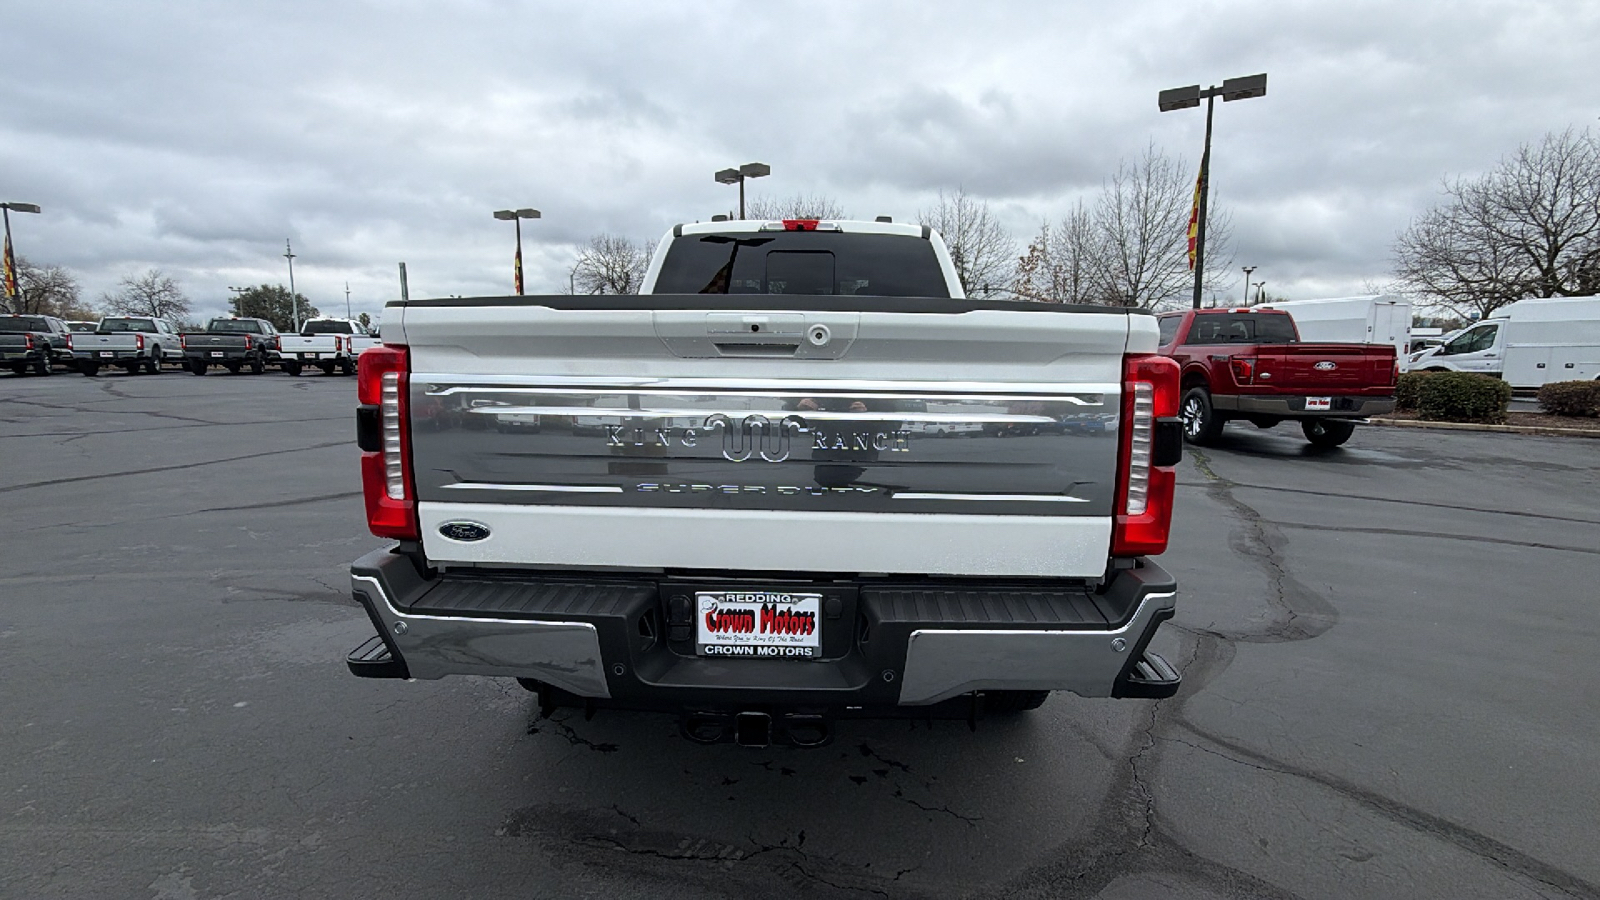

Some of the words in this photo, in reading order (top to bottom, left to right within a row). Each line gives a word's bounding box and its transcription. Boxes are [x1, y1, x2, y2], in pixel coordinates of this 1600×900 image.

[606, 425, 697, 447] KING
[811, 430, 913, 452] RANCH
[636, 482, 767, 495] SUPER
[776, 485, 879, 497] DUTY
[726, 594, 792, 603] REDDING
[705, 602, 756, 634] Crown
[760, 603, 816, 636] Motors
[704, 646, 754, 656] CROWN
[757, 646, 813, 656] MOTORS
